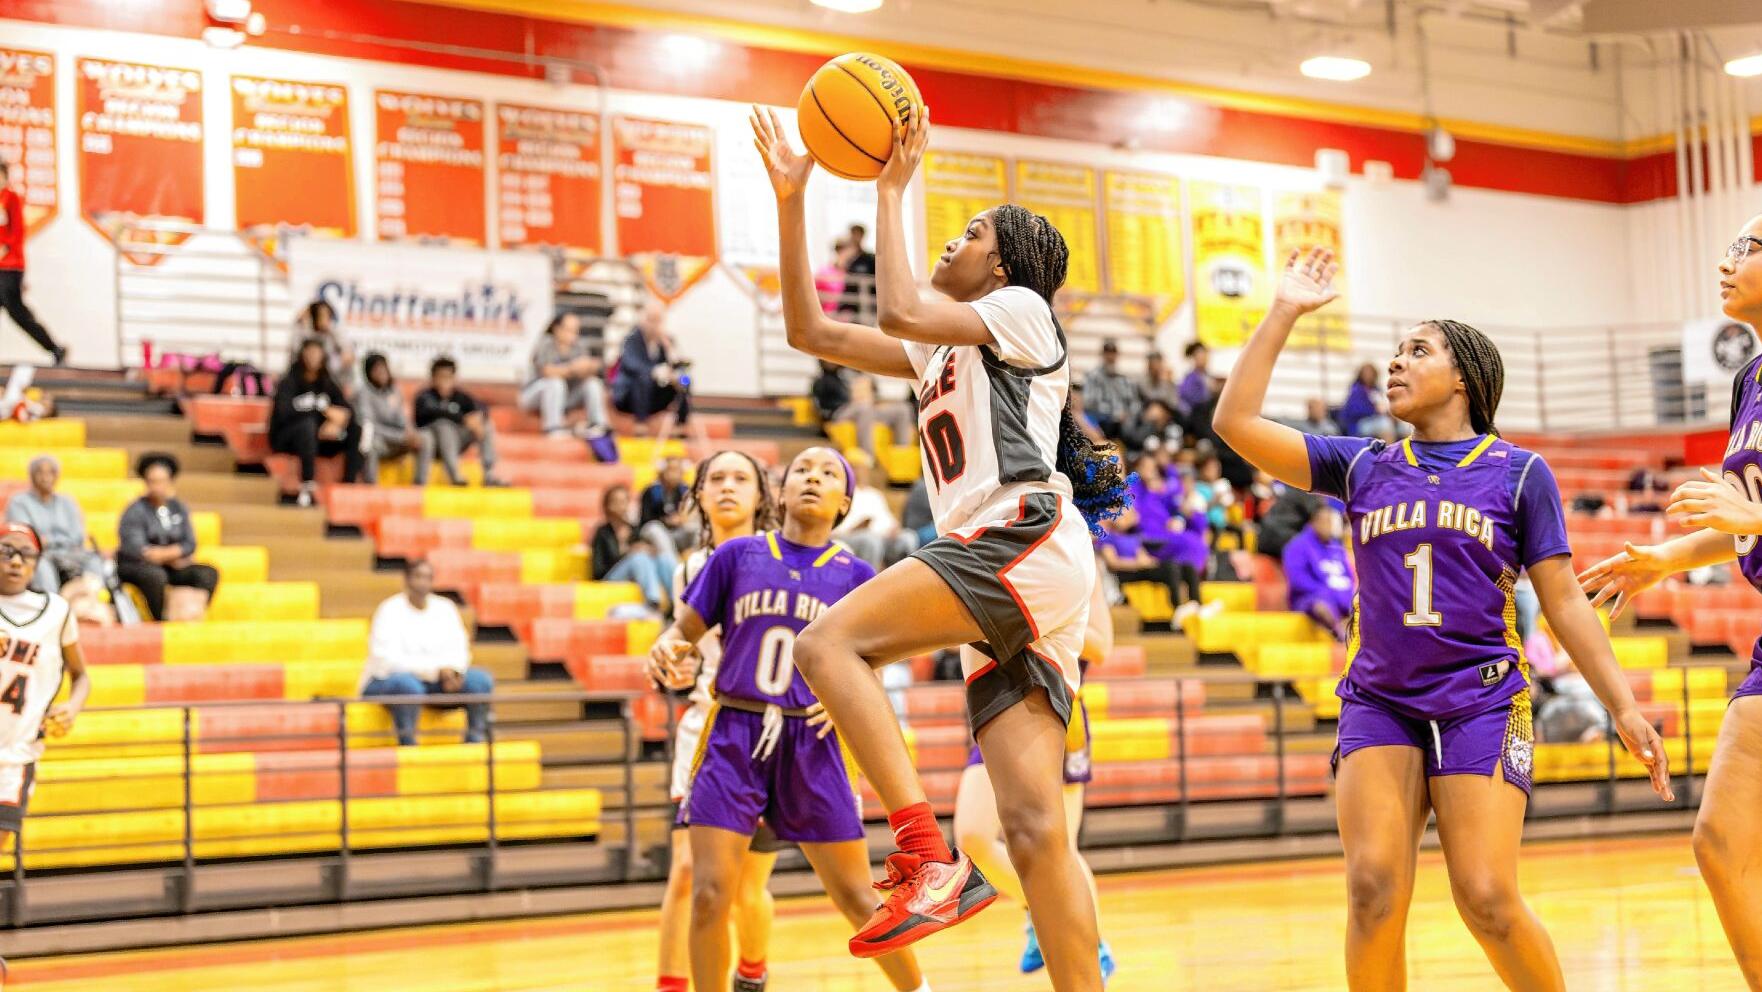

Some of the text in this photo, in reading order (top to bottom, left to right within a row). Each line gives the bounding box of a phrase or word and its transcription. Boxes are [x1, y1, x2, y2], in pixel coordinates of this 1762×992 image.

[318, 281, 523, 325] Shottenkirk
[1360, 500, 1494, 551] VILLA RICA
[734, 589, 787, 625] VILLA
[1403, 543, 1442, 627] 1
[755, 625, 796, 697] 0
[0, 673, 28, 716] 4
